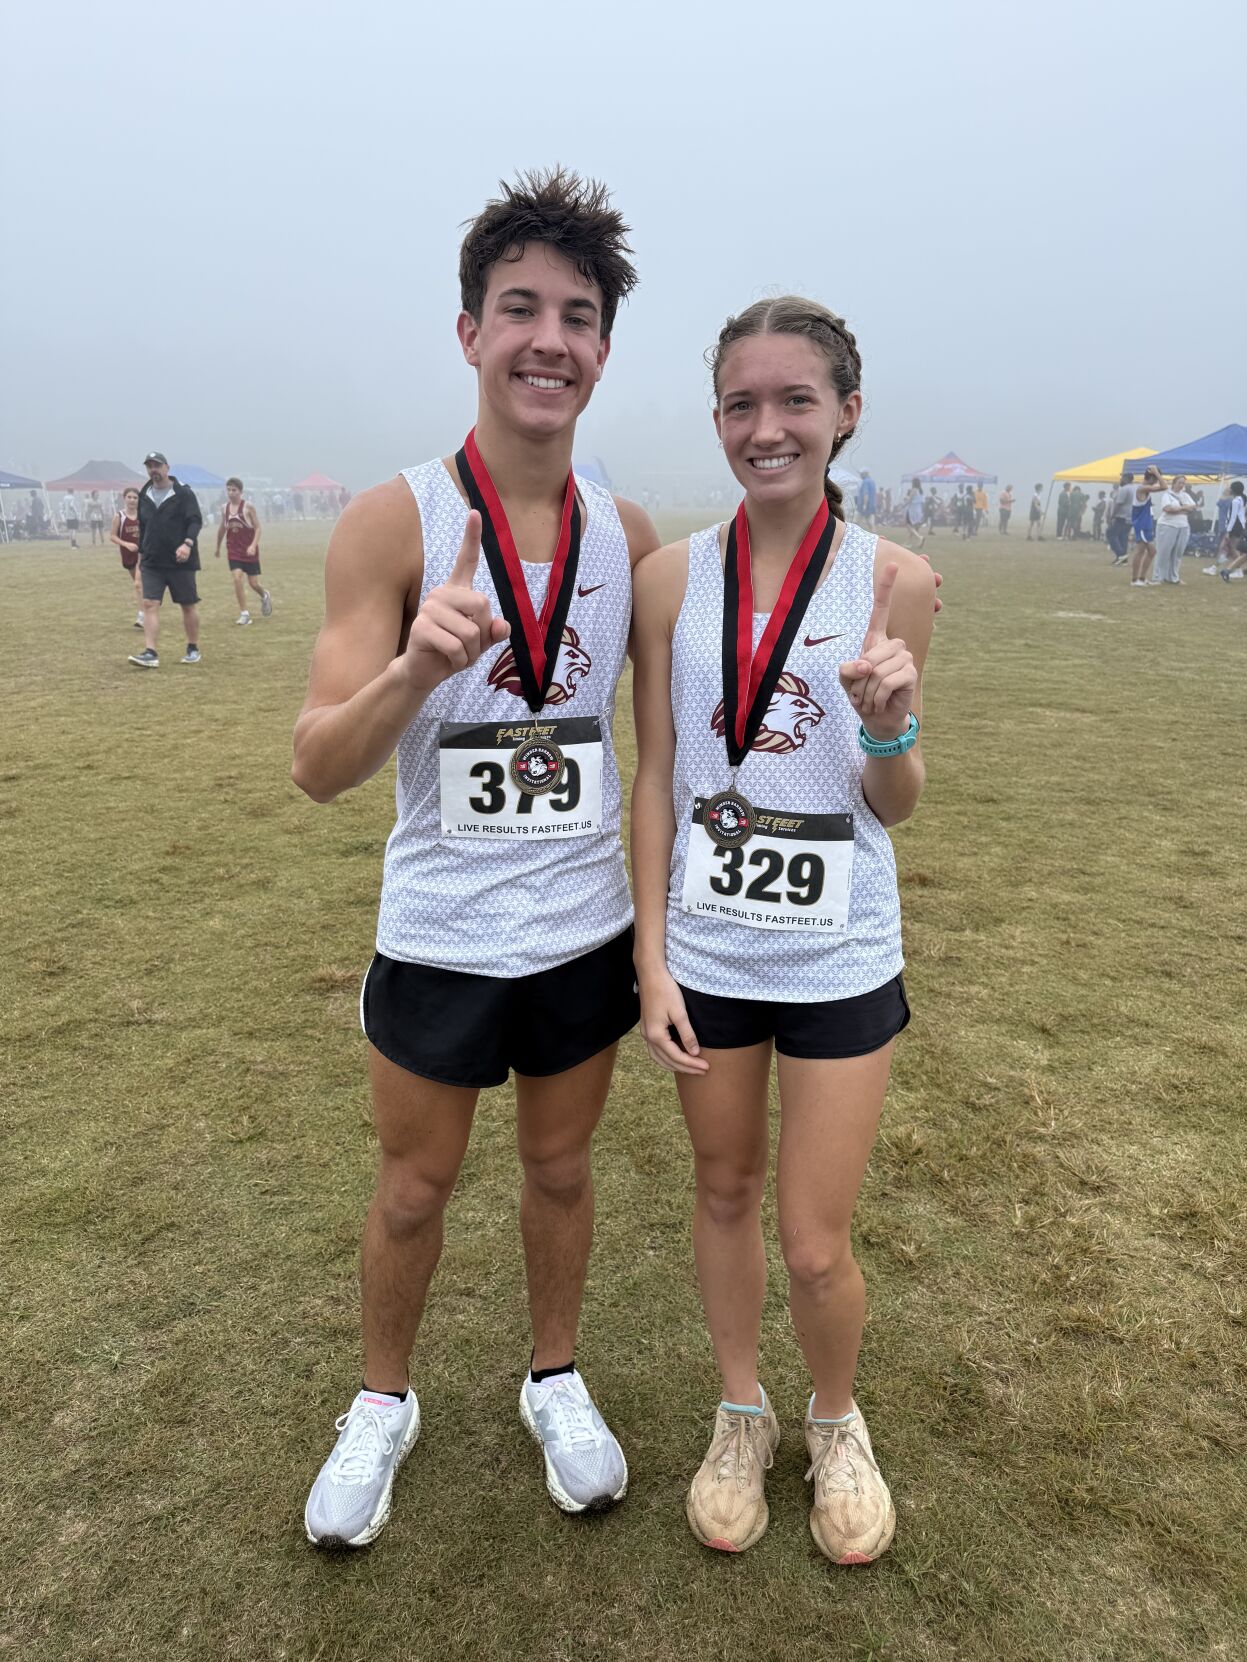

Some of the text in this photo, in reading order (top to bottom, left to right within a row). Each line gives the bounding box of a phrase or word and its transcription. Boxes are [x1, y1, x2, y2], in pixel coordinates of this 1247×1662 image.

[469, 758, 581, 815] 39
[457, 820, 592, 834] LIVE RESULTS FASTFEET.US
[709, 844, 825, 906] 329
[696, 902, 833, 927] LIVE RESULTS FASTFEET.US
